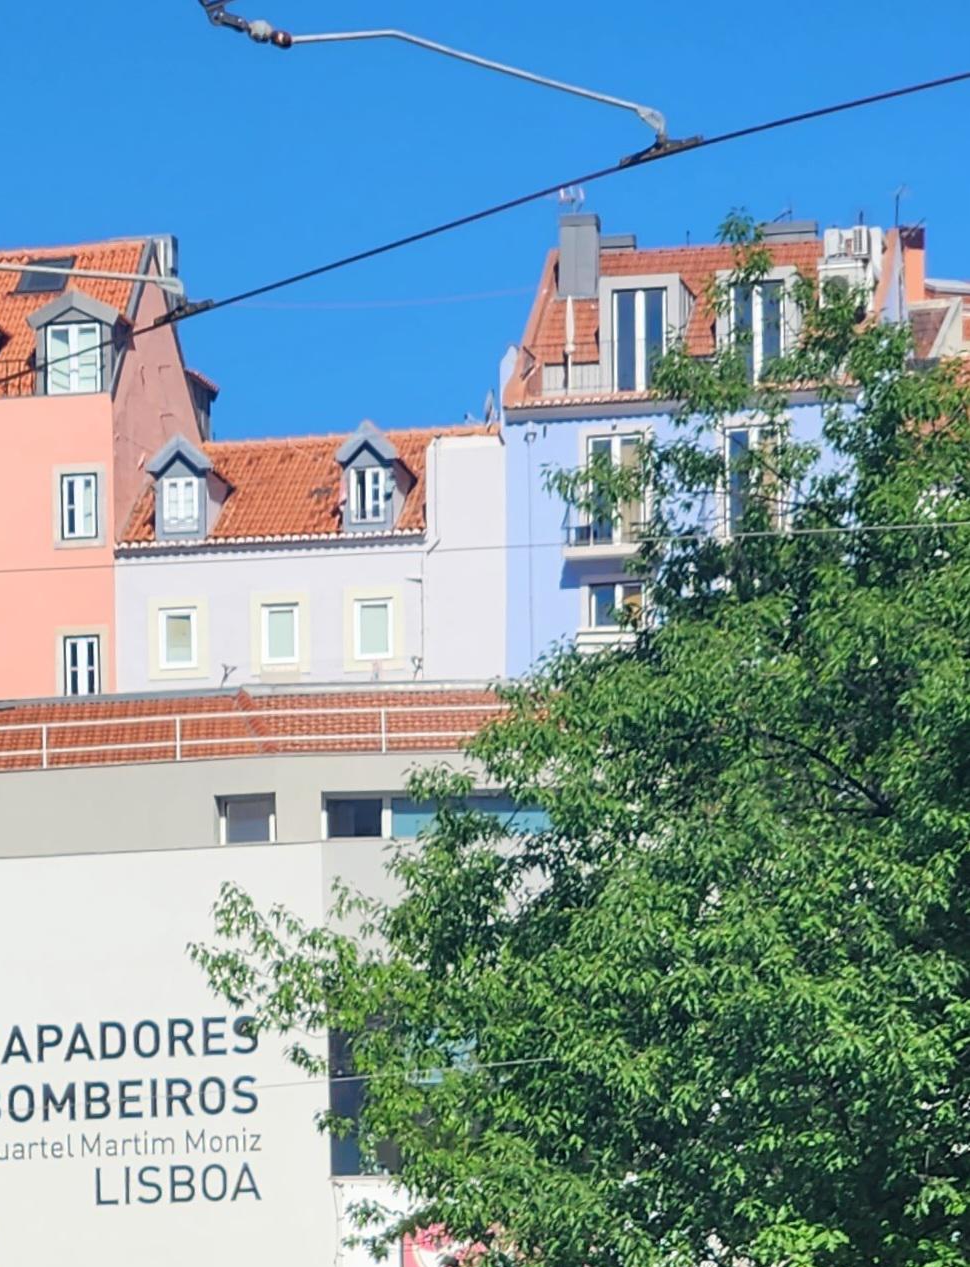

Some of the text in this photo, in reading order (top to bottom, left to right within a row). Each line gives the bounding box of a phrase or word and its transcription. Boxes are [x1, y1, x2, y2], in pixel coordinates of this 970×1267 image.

[81, 1129, 176, 1158] Martim
[185, 1127, 262, 1155] Moniz
[95, 1162, 262, 1206] LISBOA
